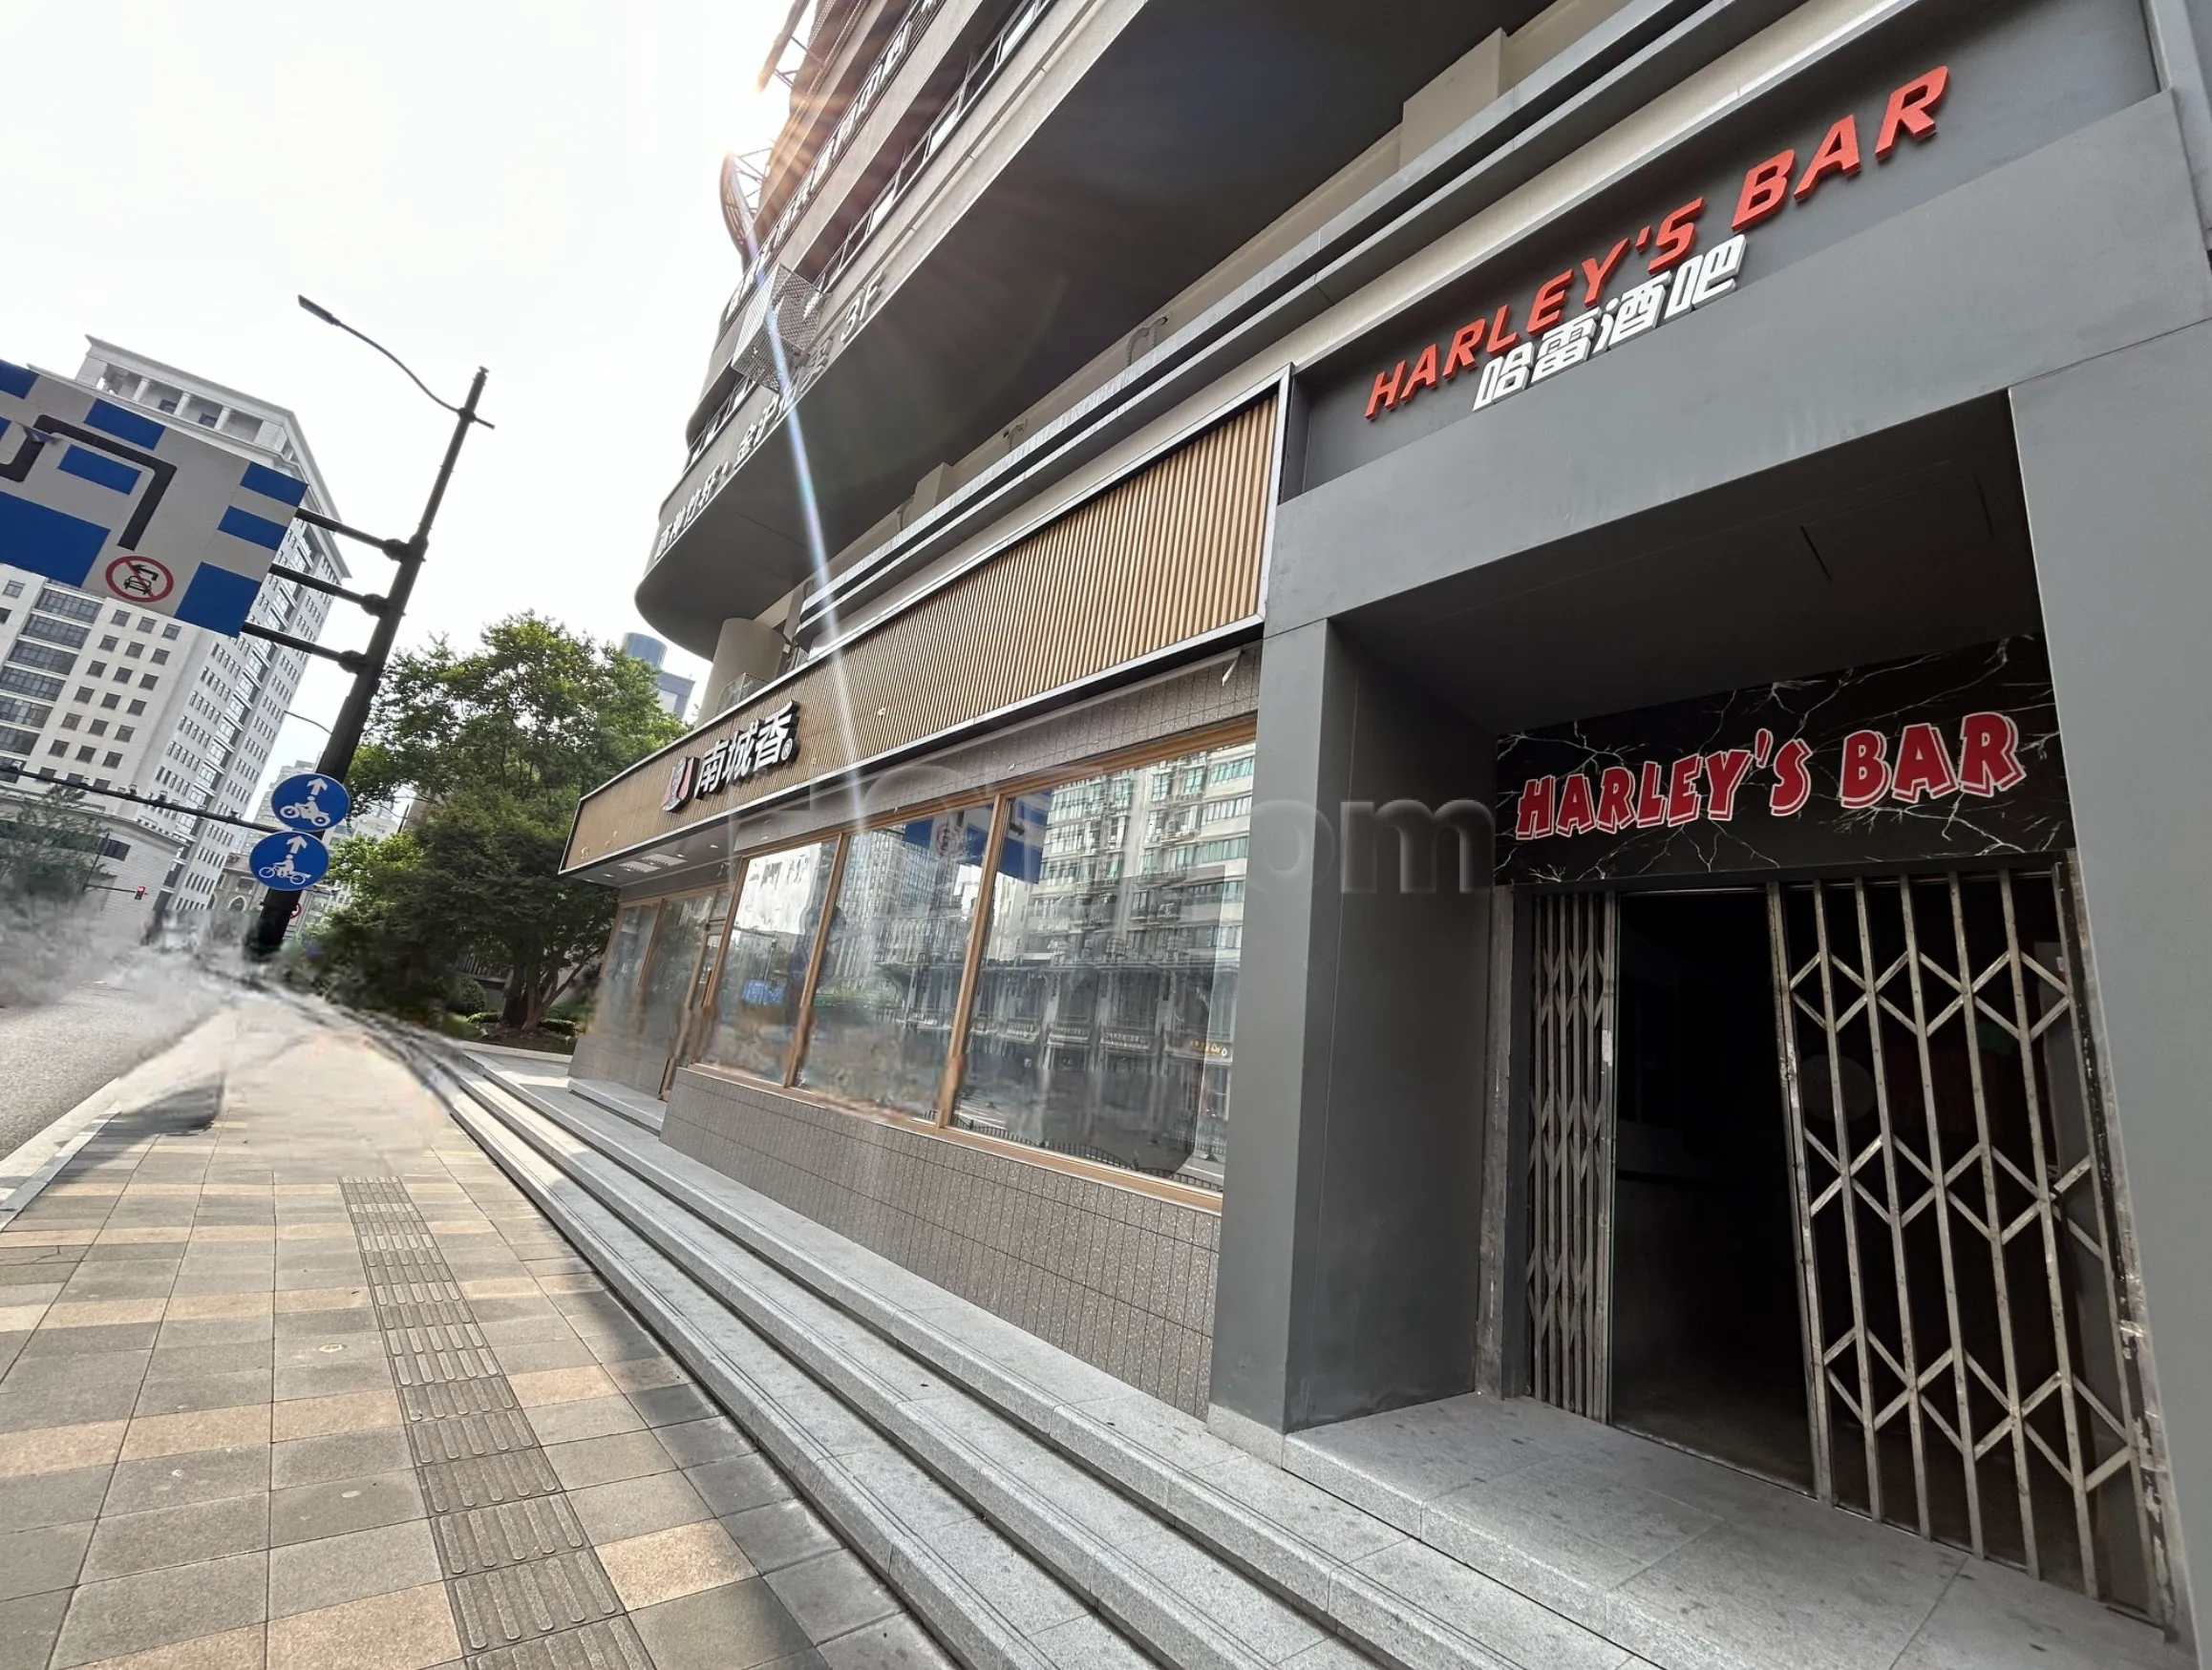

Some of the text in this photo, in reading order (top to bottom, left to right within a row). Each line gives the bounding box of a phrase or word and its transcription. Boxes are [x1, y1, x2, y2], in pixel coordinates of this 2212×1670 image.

[840, 270, 883, 343] 3F
[1363, 65, 1949, 421] HARLEY'S BAR
[1473, 234, 1747, 412] 哈雷酒吧
[694, 700, 795, 799] 南城香
[1515, 710, 2028, 841] HARLEY'S BAR
